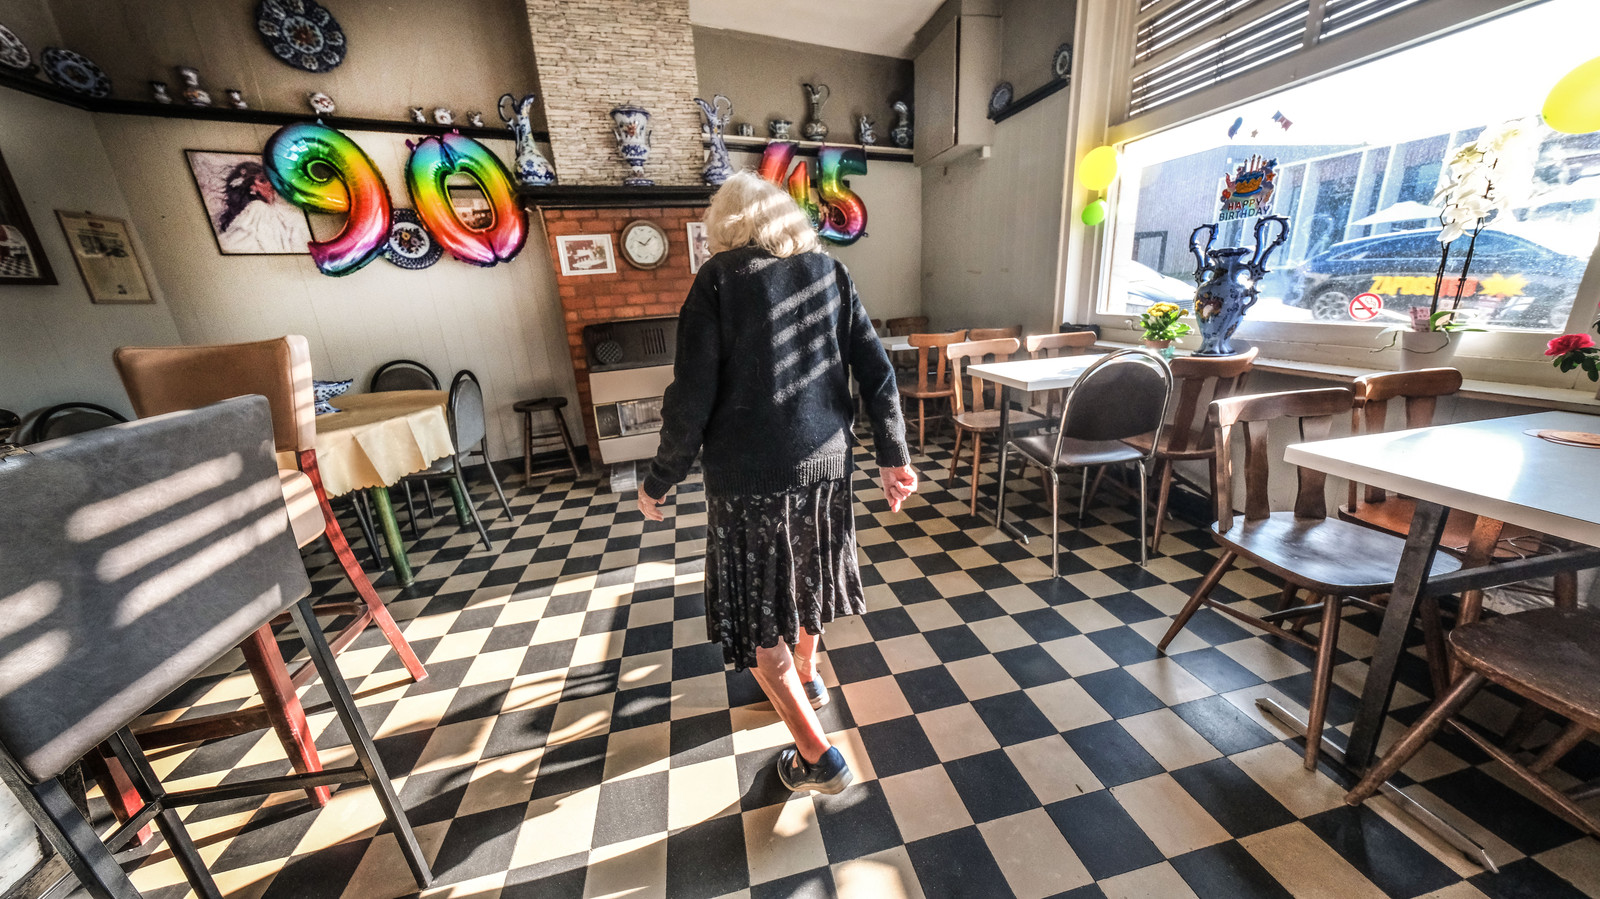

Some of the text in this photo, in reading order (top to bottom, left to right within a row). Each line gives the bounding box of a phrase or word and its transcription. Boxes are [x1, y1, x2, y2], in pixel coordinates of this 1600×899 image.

[264, 121, 529, 278] 90
[1228, 197, 1262, 211] HAPPY
[1219, 205, 1270, 221] BIRTHDAY
